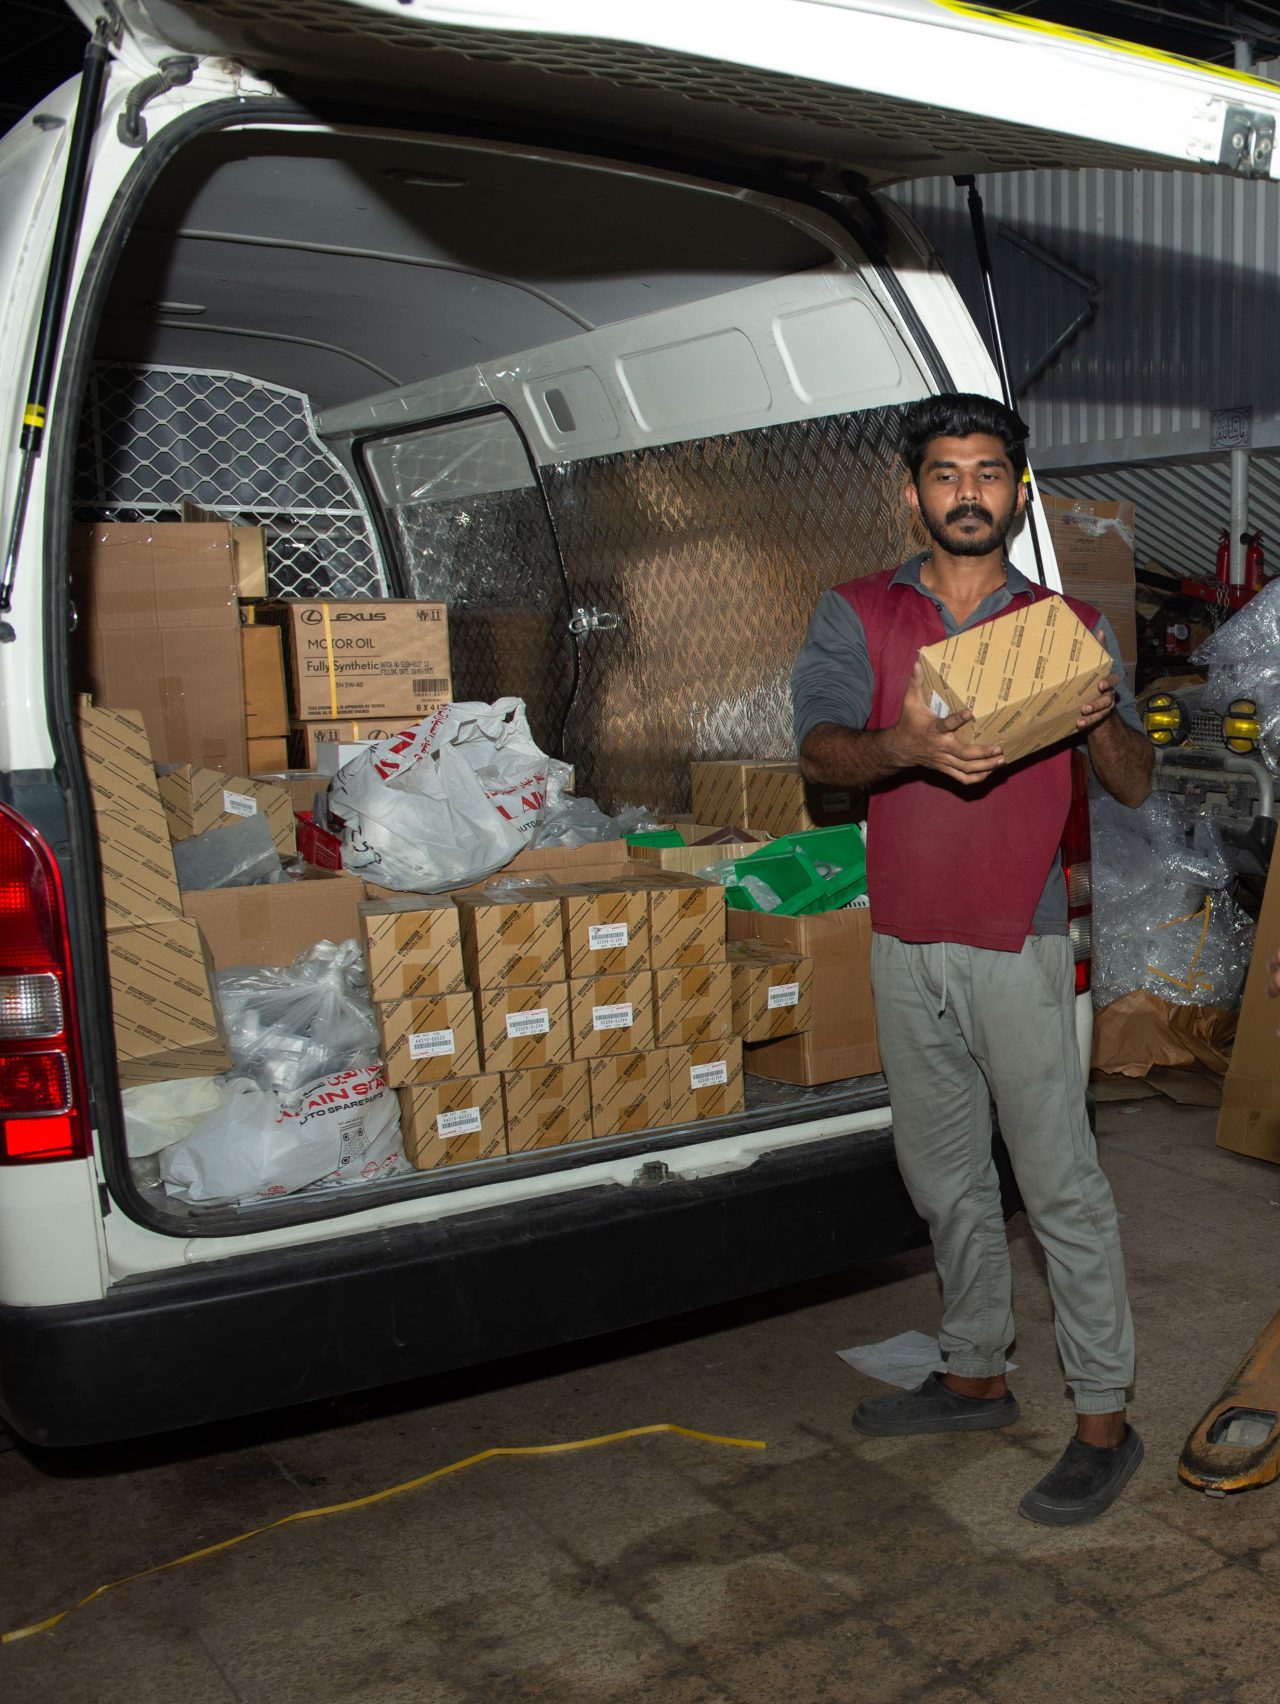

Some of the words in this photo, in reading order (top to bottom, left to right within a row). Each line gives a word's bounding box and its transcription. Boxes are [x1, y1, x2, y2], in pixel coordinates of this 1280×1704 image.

[355, 638, 376, 649] OIL
[306, 661, 330, 673] Fully
[333, 659, 380, 673] Synthetic
[308, 1087, 350, 1111] AIN
[352, 1074, 386, 1097] STA
[327, 1098, 365, 1115] SPARE
